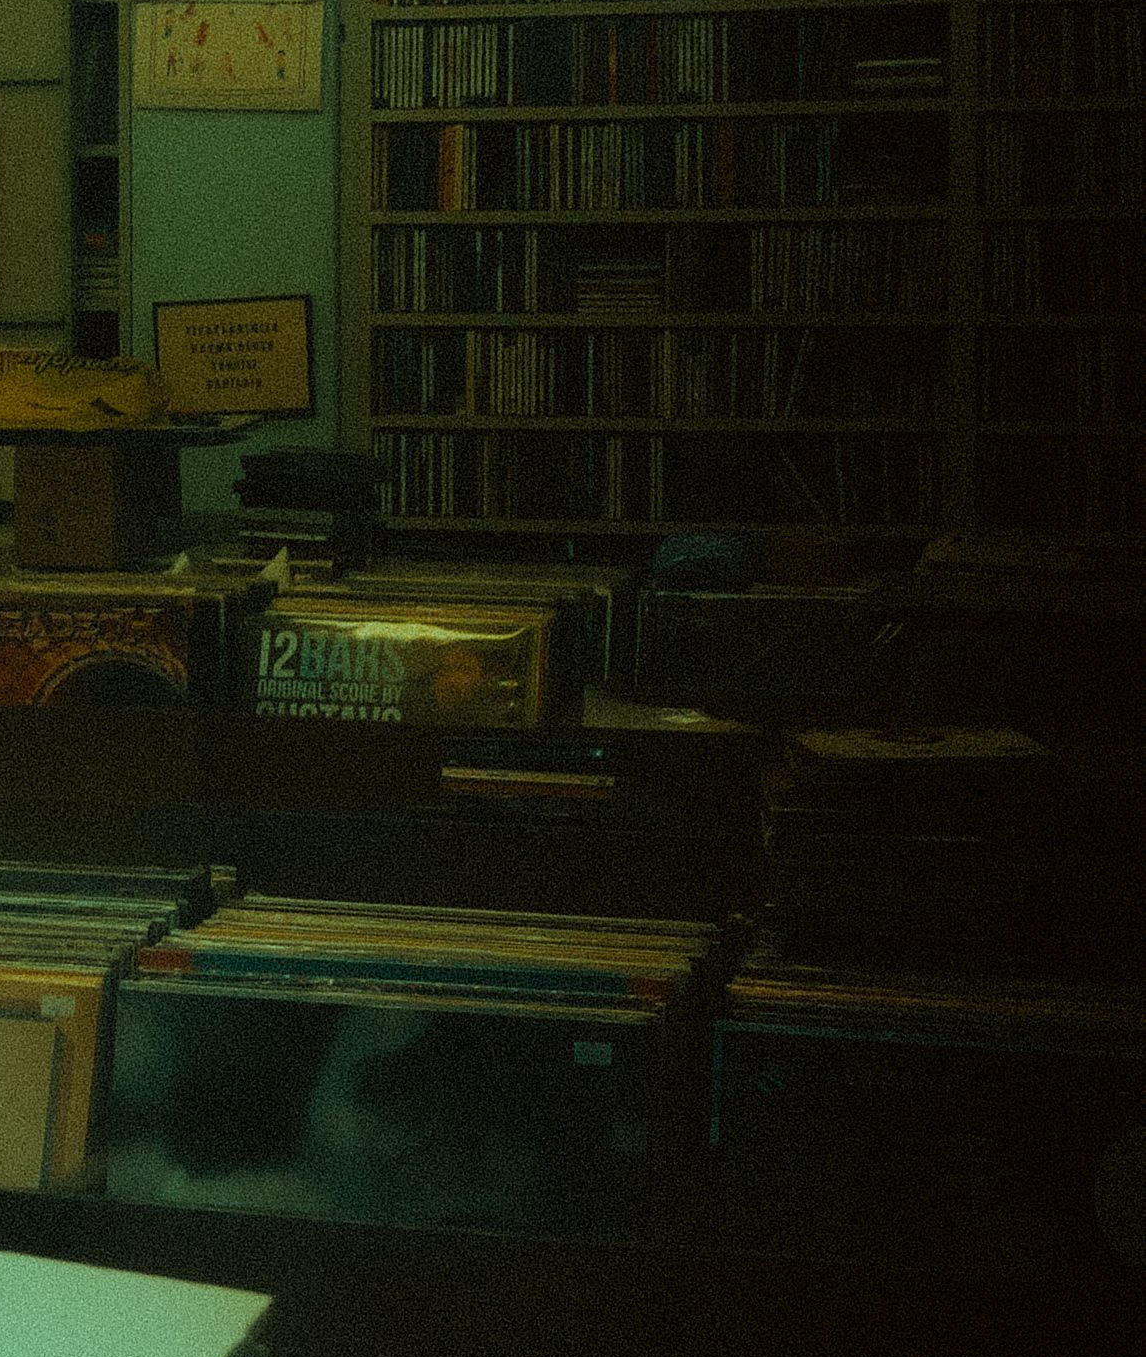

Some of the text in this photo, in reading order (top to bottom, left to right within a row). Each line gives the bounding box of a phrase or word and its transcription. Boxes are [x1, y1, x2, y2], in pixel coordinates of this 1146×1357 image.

[256, 678, 403, 705] ORIGINAL SCORE BY
